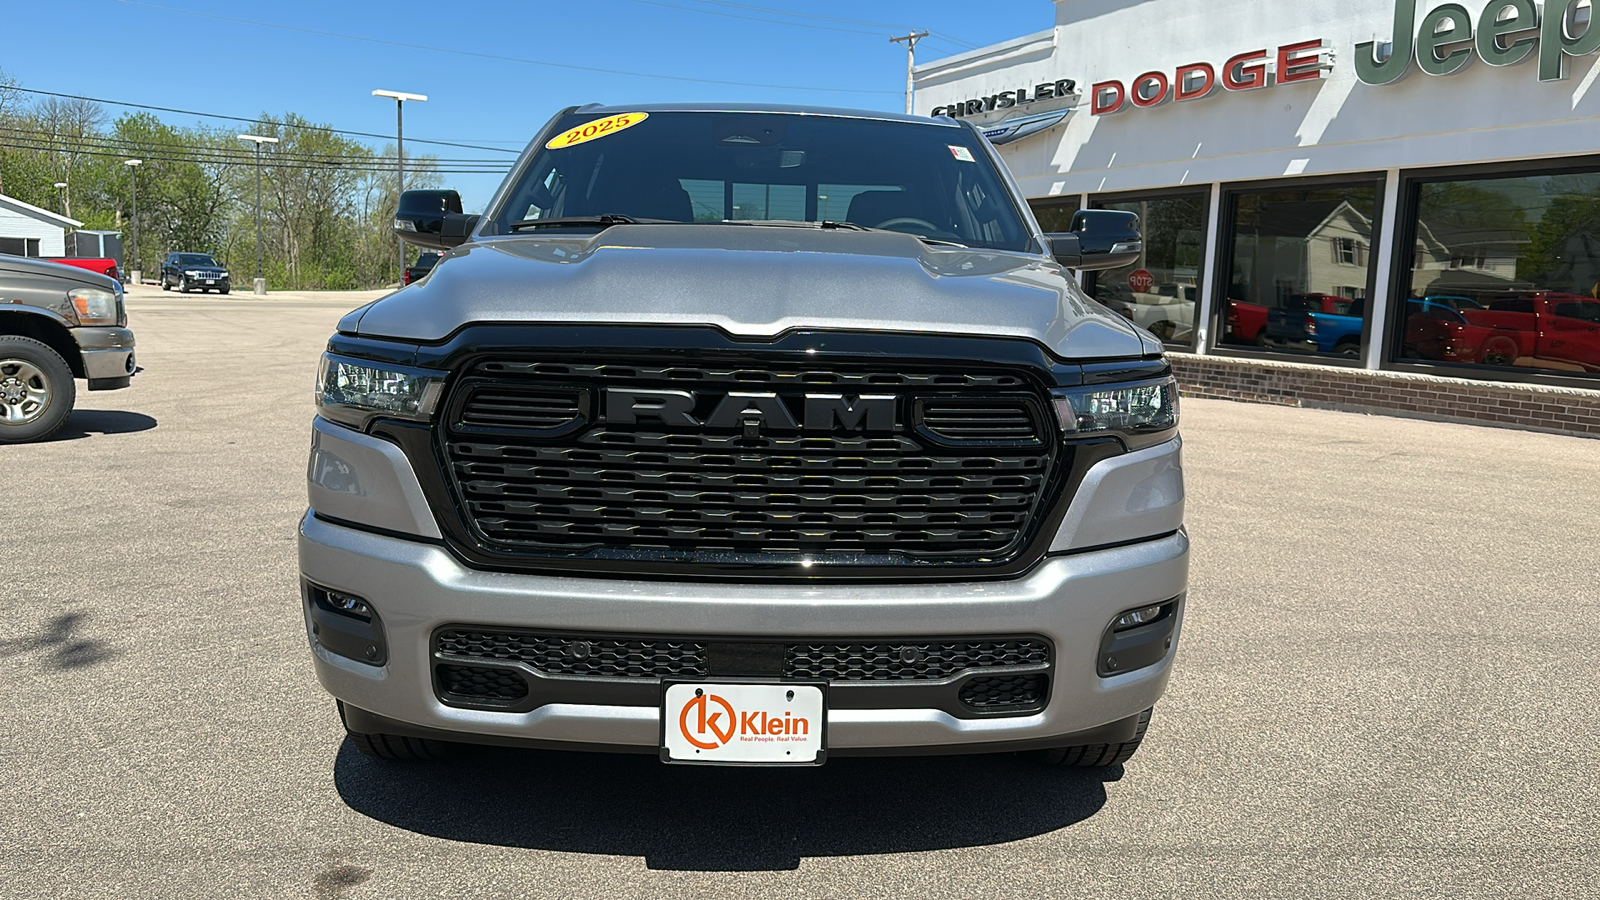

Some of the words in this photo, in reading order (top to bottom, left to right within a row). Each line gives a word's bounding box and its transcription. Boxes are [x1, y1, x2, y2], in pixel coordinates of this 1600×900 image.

[1354, 0, 1600, 86] Jeep
[1091, 38, 1325, 116] DODGE
[931, 79, 1076, 118] CHRYSLER
[566, 115, 630, 144] 2025
[606, 387, 897, 431] RAM
[740, 711, 809, 735] Klein
